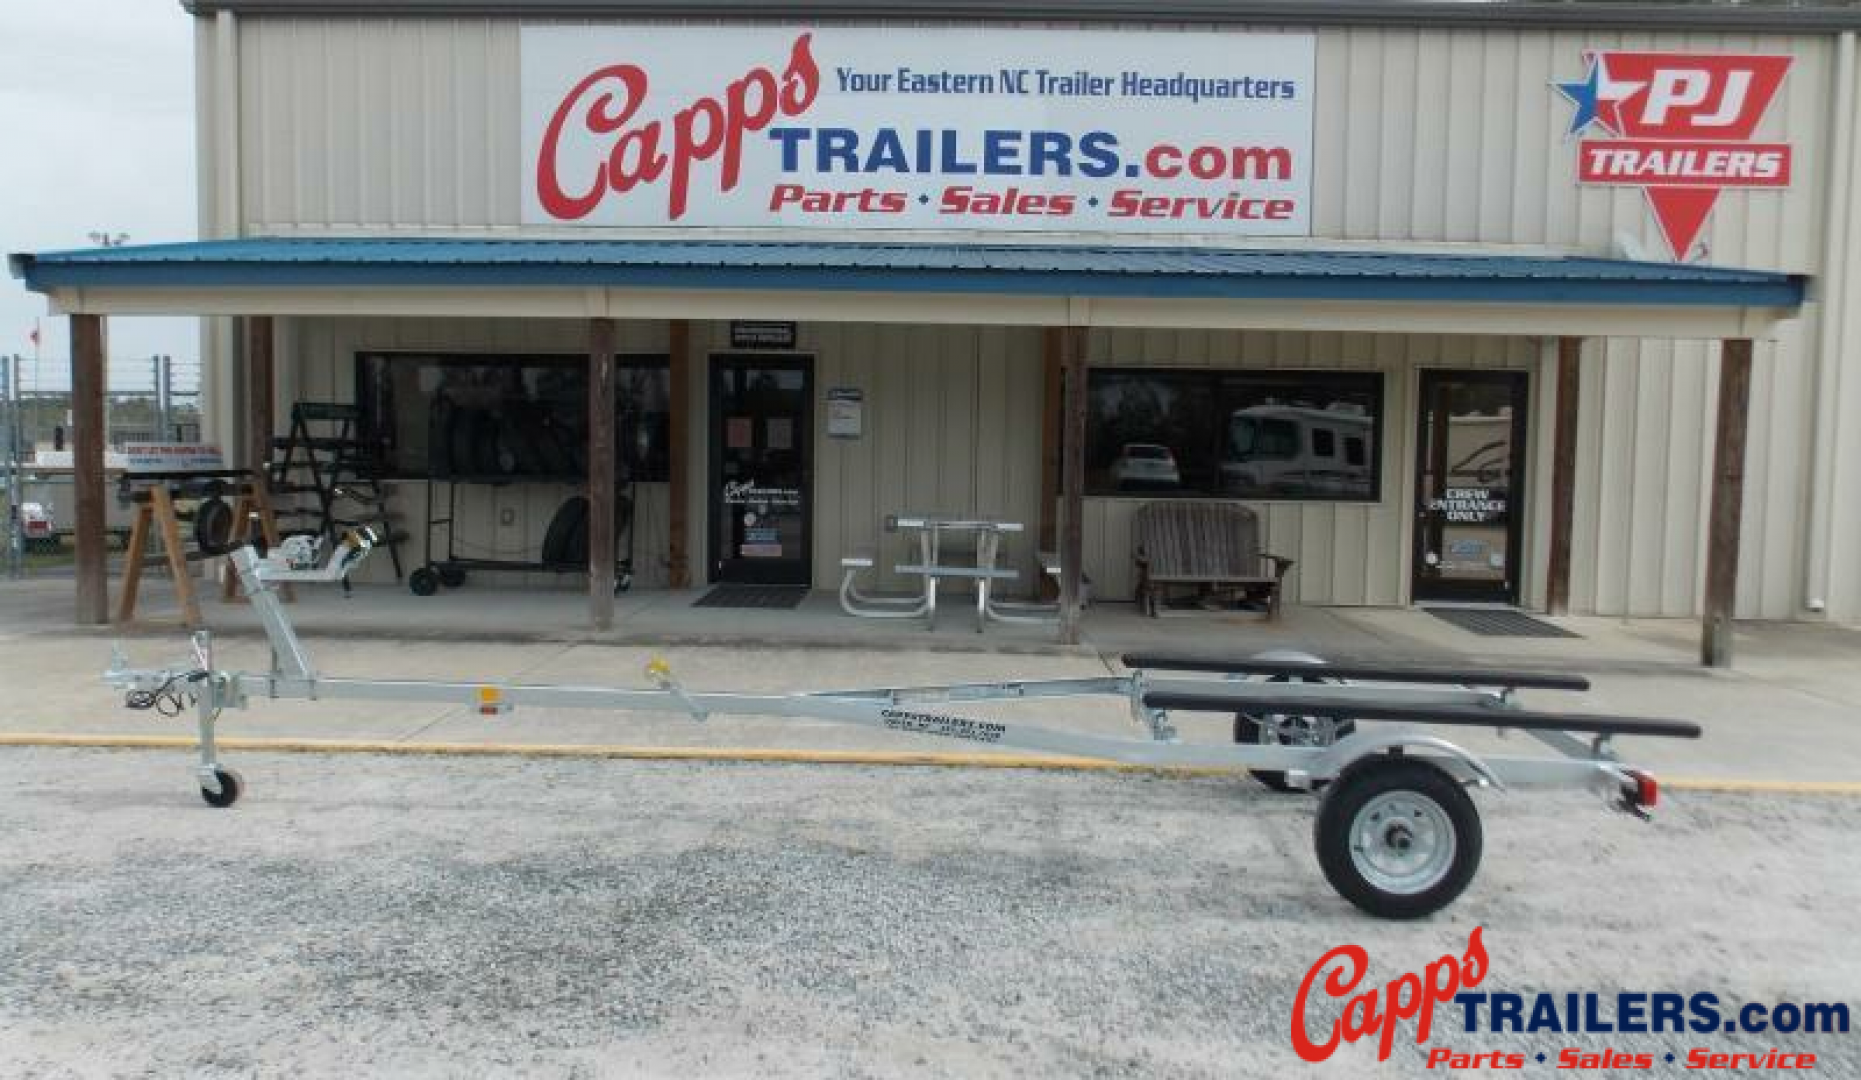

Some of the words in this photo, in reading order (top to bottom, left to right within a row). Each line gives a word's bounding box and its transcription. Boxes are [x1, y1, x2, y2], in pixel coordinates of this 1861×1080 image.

[836, 67, 892, 92] Your
[897, 67, 994, 94] Eastern
[999, 69, 1029, 94] NC
[1034, 69, 1115, 96] Trailer
[1121, 71, 1295, 103] Headquarters
[1641, 69, 1753, 126] PJ
[535, 32, 821, 221] Capps
[768, 127, 1293, 180] TRAILERS.com
[1590, 148, 1783, 178] TRAILERS
[769, 185, 906, 213] Parts
[939, 187, 1075, 216] Sales
[1107, 190, 1295, 219] Service
